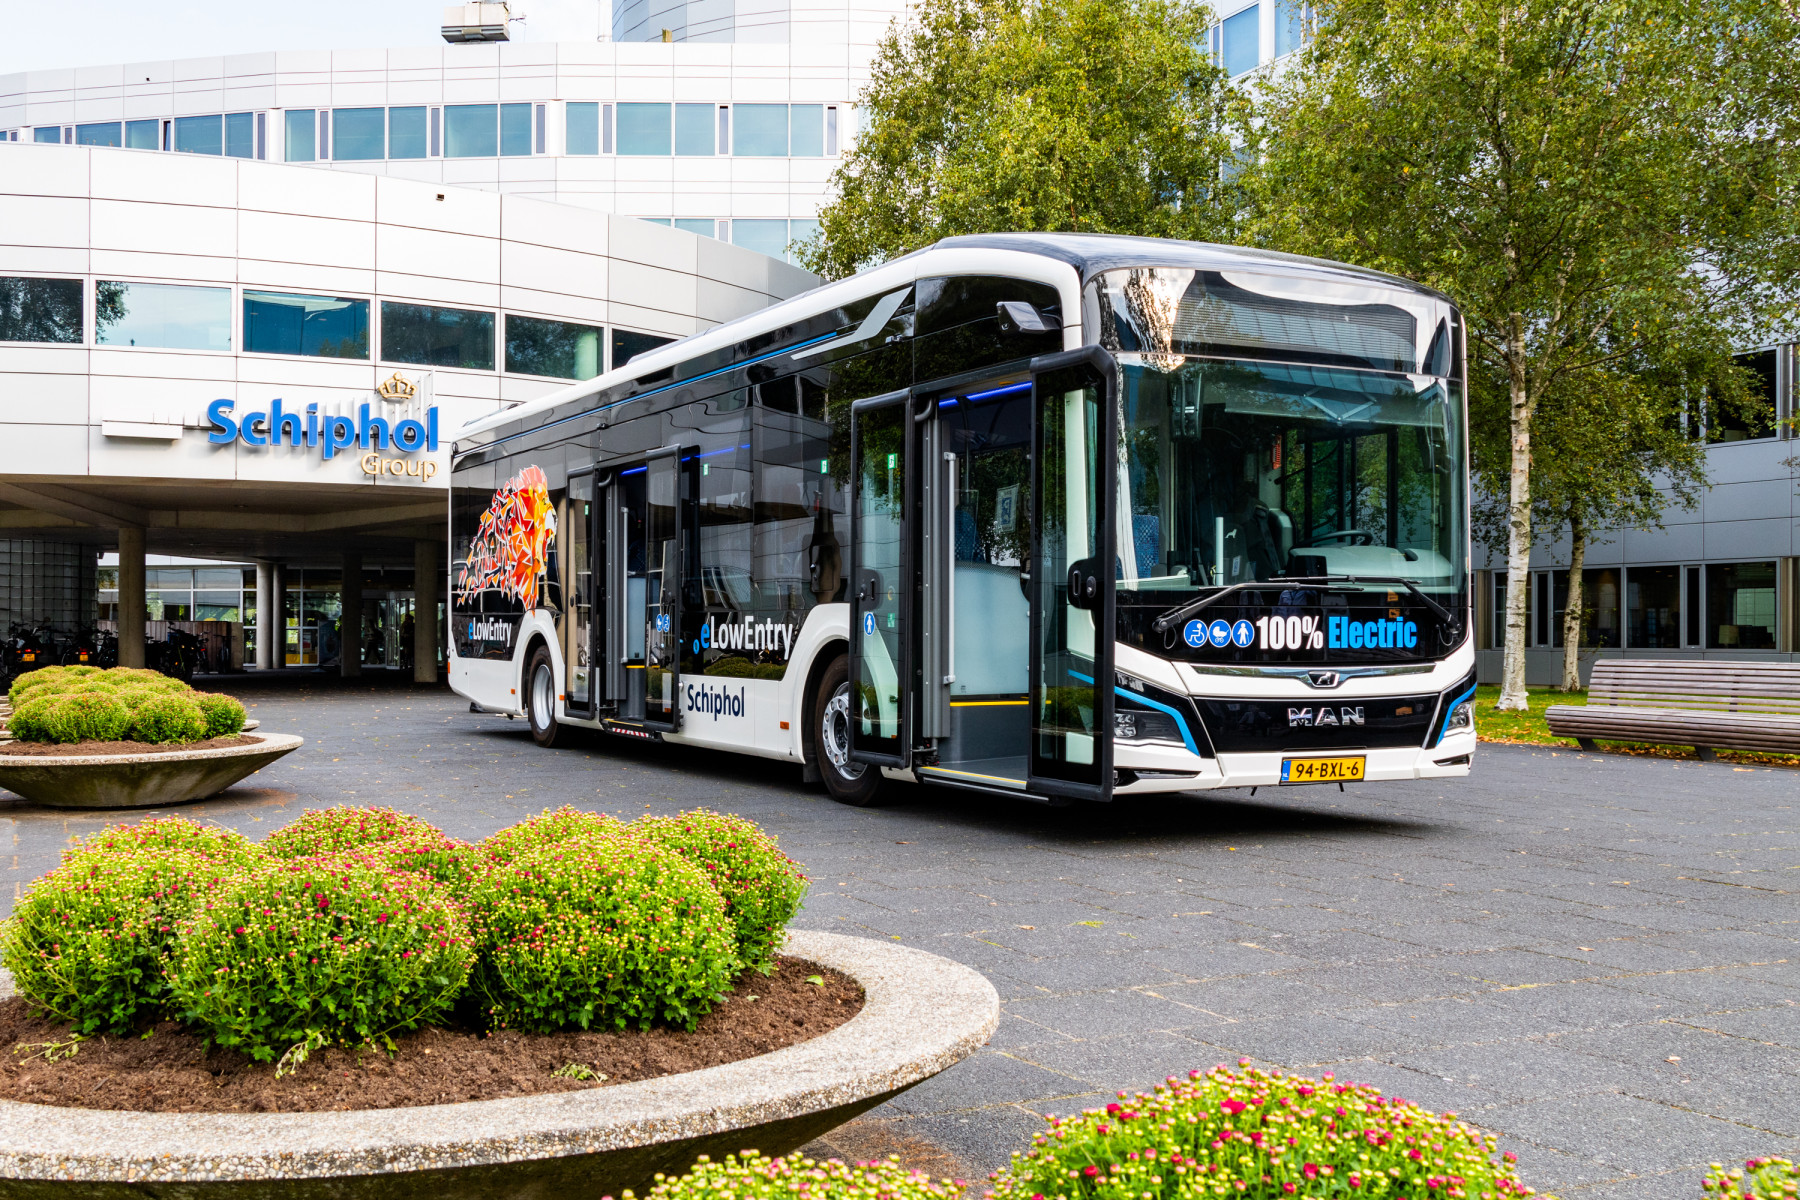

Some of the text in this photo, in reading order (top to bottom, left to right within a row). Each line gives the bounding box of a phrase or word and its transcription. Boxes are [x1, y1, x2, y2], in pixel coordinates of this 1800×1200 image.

[207, 398, 439, 460] Schiphol
[361, 452, 438, 482] Group
[468, 616, 512, 648] eLowEntry
[700, 615, 793, 660] eLowEntry
[1256, 615, 1417, 650] 100% Electric
[687, 683, 745, 722] Schiphol
[1287, 706, 1365, 727] MAN
[1295, 761, 1359, 779] 94-BXL-6
